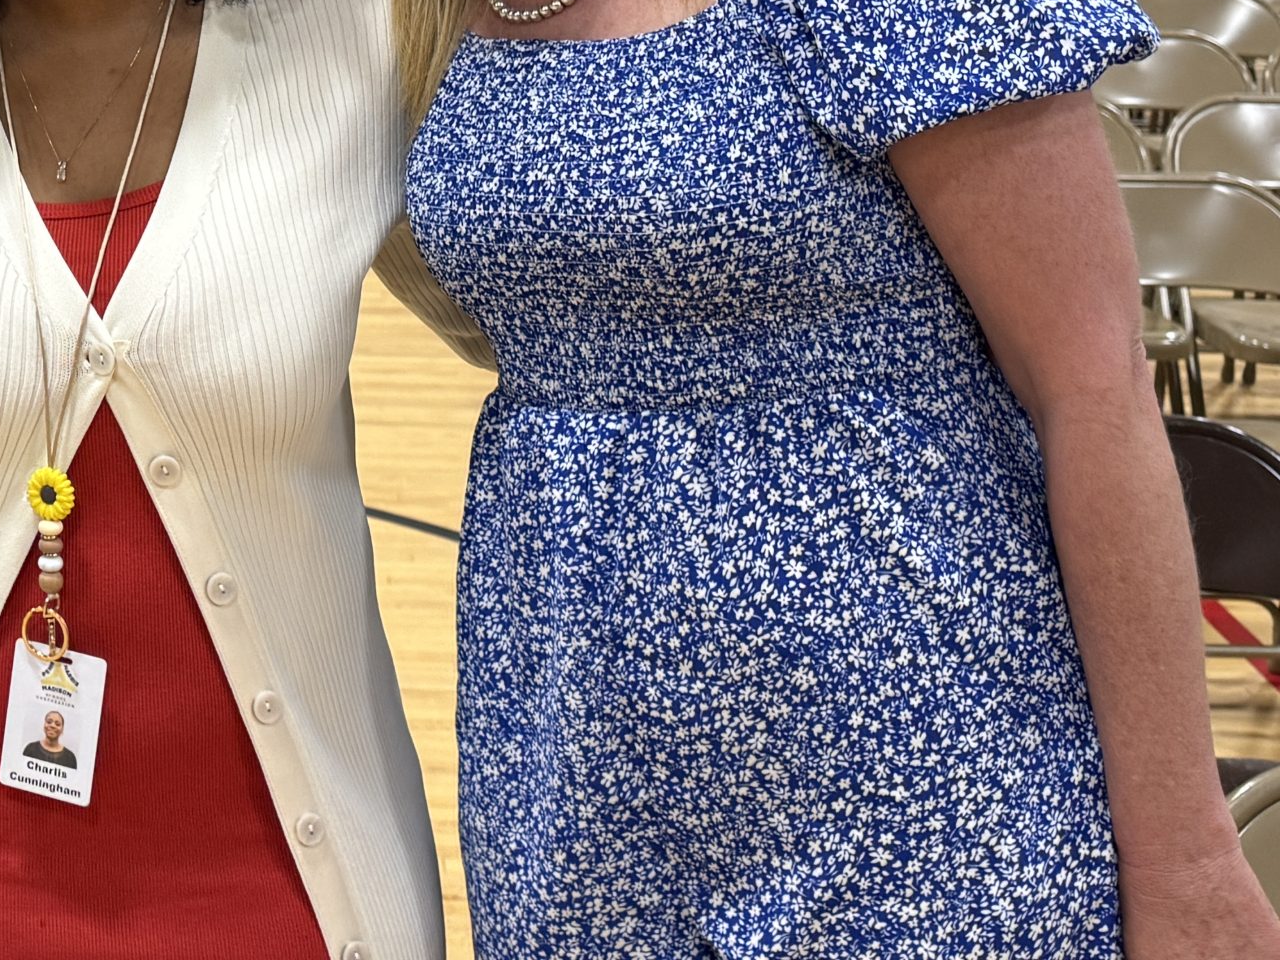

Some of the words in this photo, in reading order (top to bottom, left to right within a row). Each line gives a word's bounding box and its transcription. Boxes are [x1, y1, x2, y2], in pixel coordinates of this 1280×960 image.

[41, 685, 72, 698] MADISON
[27, 760, 67, 779] Charlis
[9, 771, 81, 798] Cunningham
